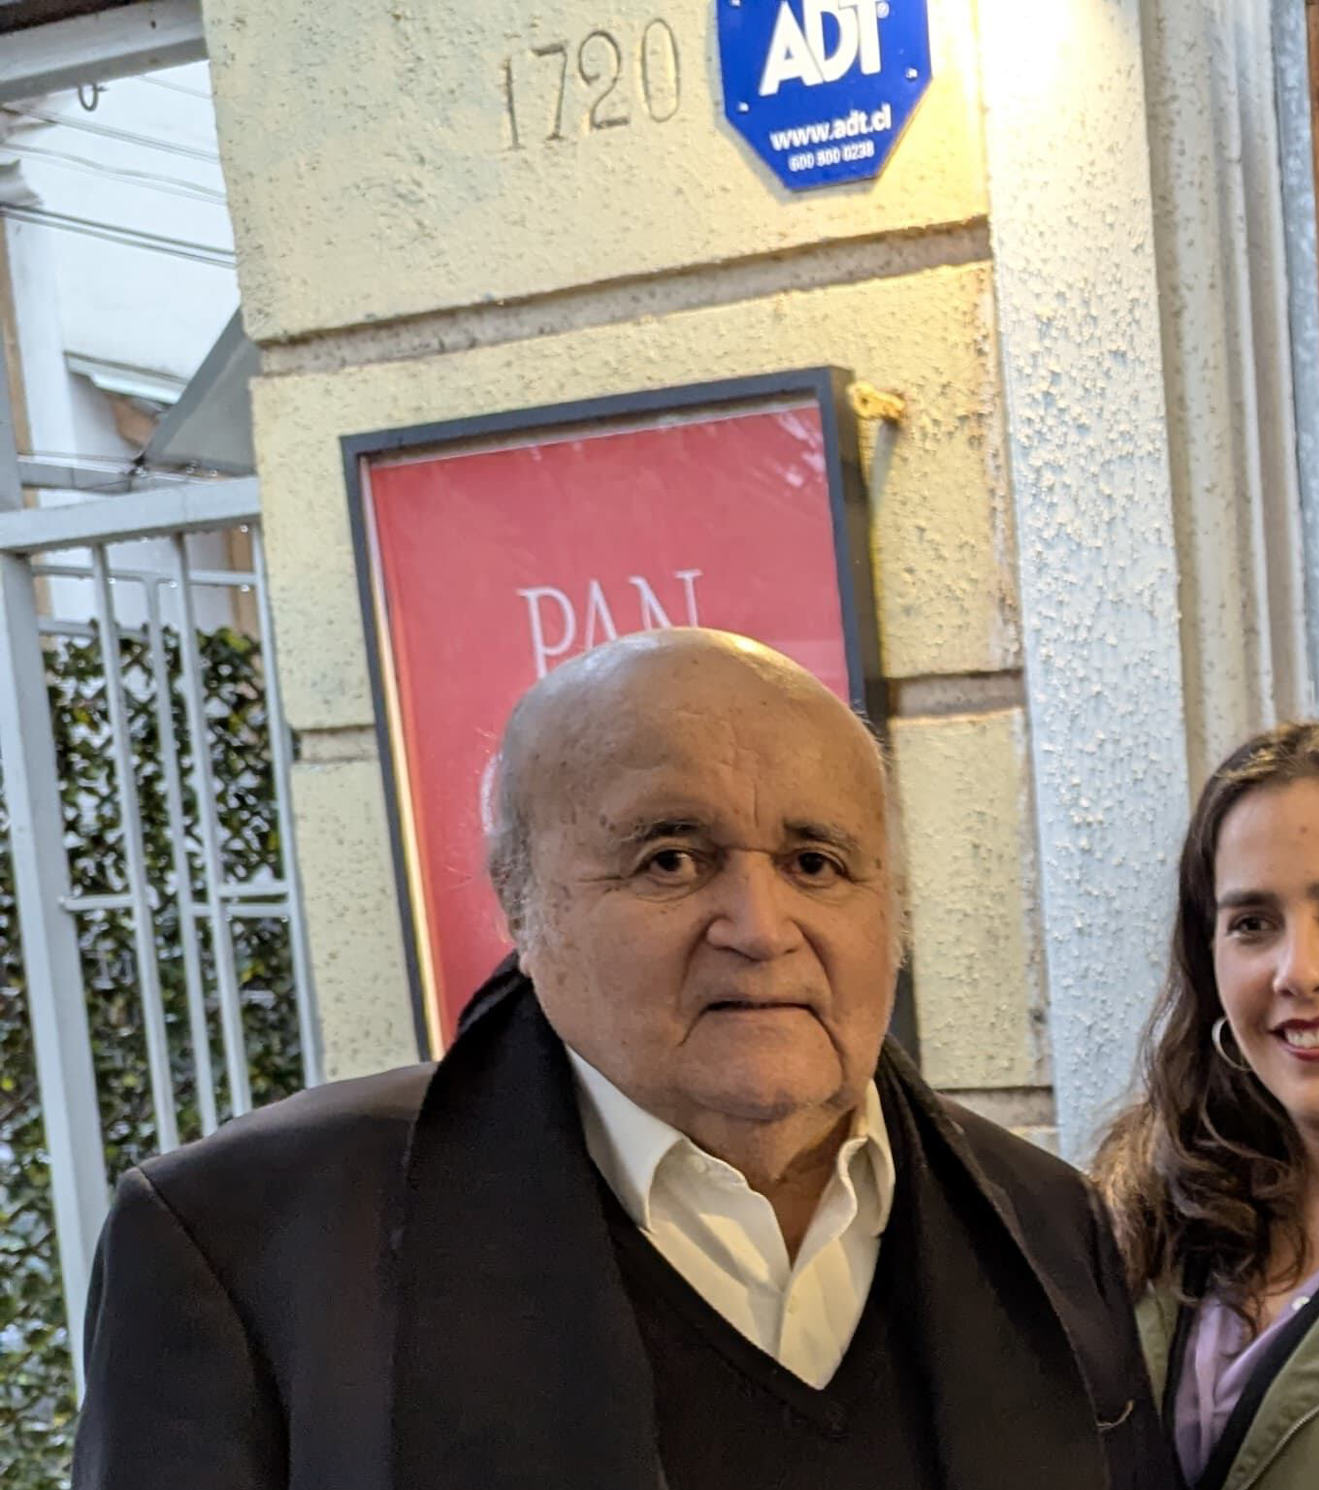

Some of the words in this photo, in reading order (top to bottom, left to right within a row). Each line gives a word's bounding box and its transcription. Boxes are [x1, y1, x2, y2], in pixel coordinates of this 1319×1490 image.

[502, 17, 685, 150] 1720
[758, 0, 882, 96] ADT
[769, 103, 892, 151] www.adt.cl
